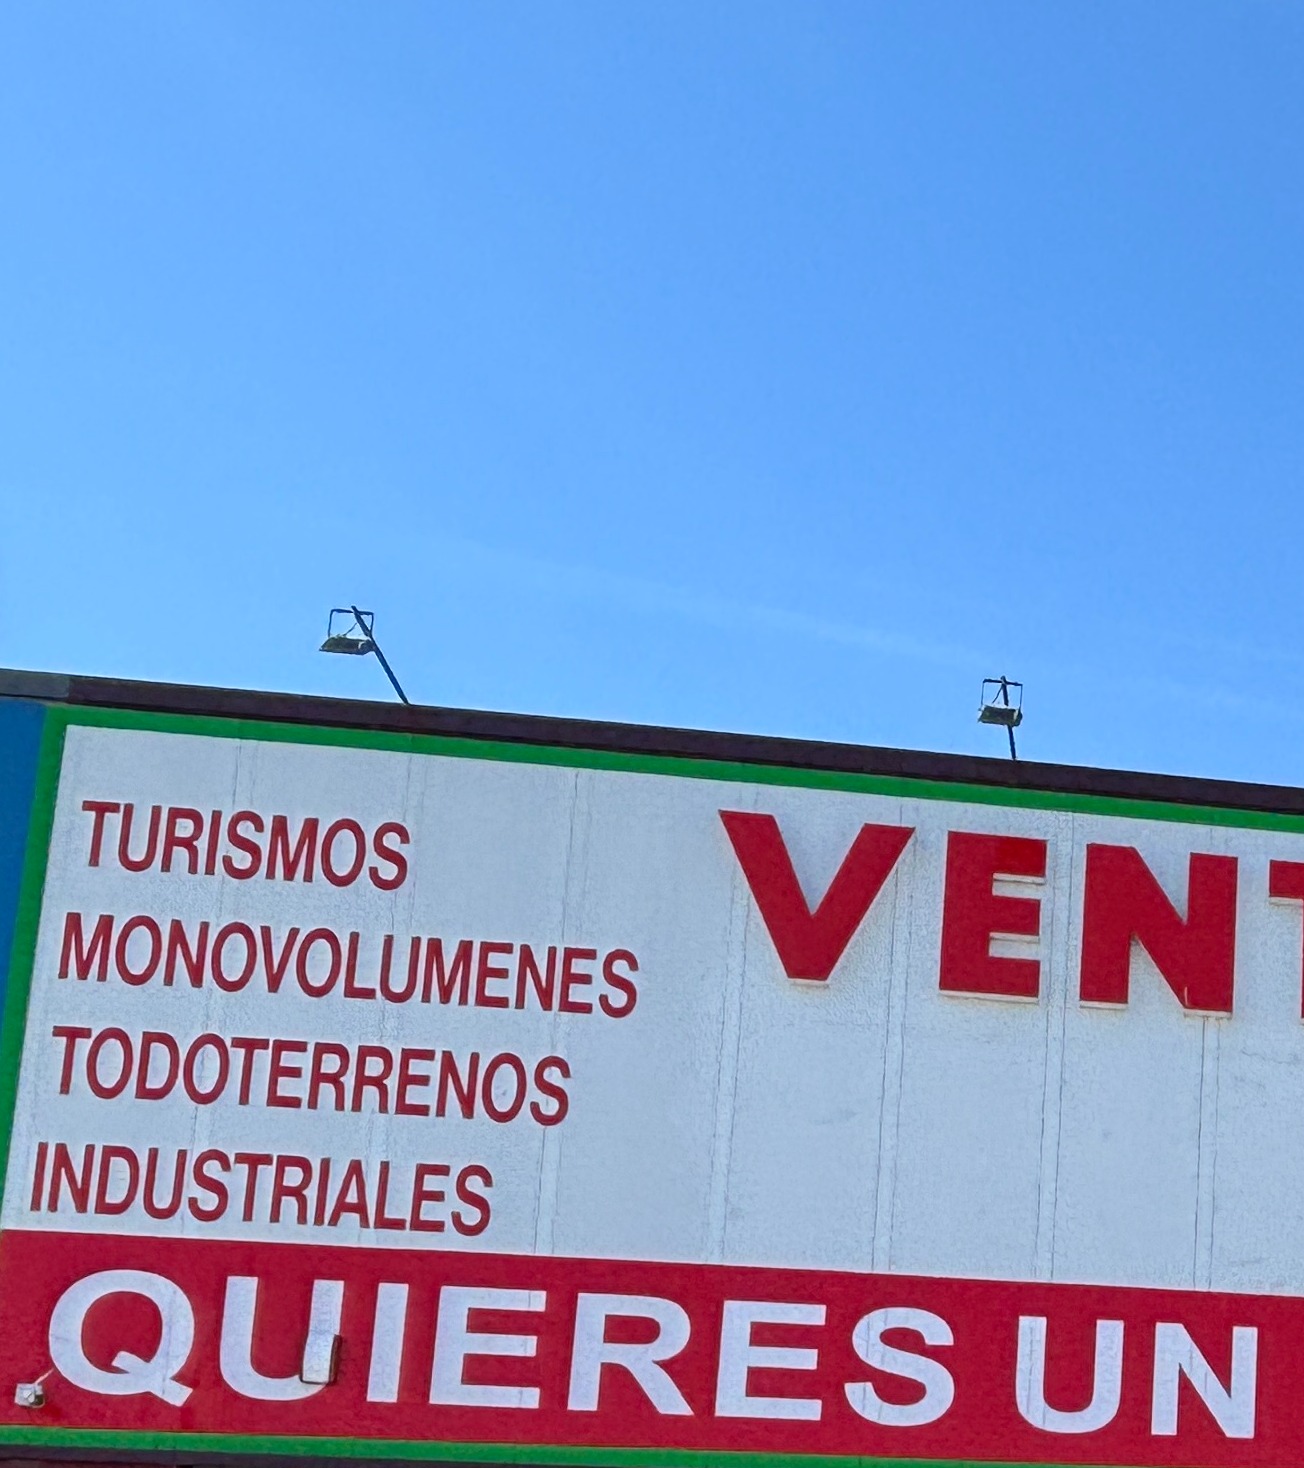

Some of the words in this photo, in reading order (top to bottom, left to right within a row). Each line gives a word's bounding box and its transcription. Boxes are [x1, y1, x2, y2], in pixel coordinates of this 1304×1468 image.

[83, 801, 409, 891] TURISMOS
[60, 913, 637, 1018] MONOVOLUMENES
[54, 1026, 569, 1126] TODOTERRENOS
[32, 1143, 492, 1236] INDUSTRIALES
[49, 1270, 954, 1426] QUIERES
[1016, 1316, 1257, 1438] UN
